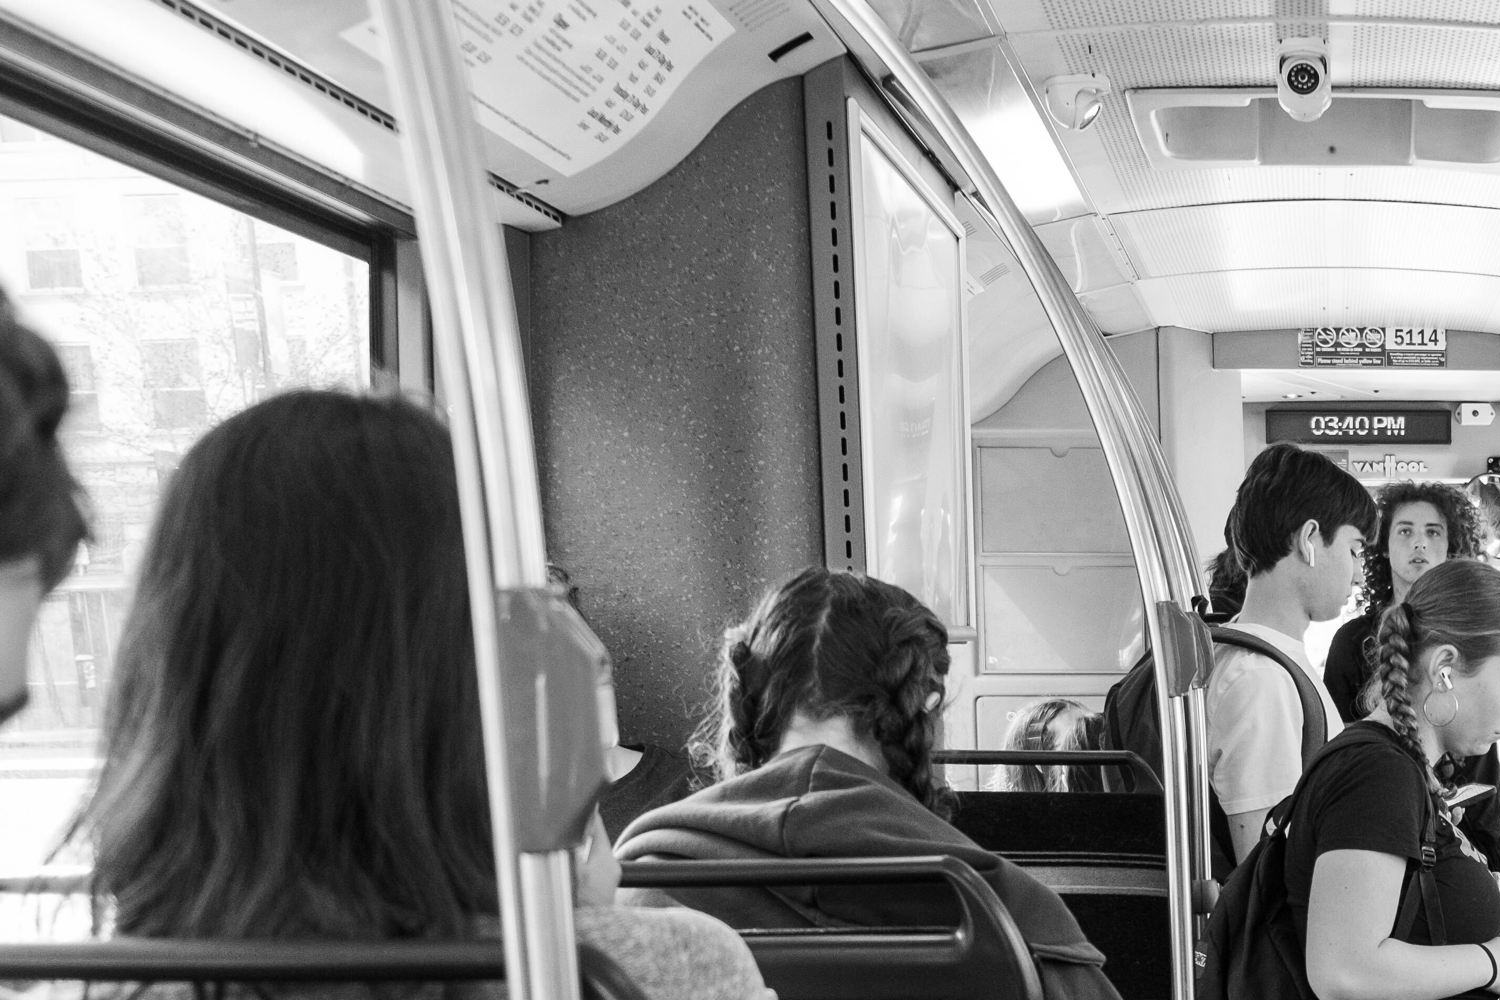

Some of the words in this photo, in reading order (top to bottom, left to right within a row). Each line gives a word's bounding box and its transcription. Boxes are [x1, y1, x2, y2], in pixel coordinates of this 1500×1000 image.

[1394, 328, 1440, 346] 5114
[1310, 416, 1370, 436] 03:40
[1373, 416, 1405, 436] PM
